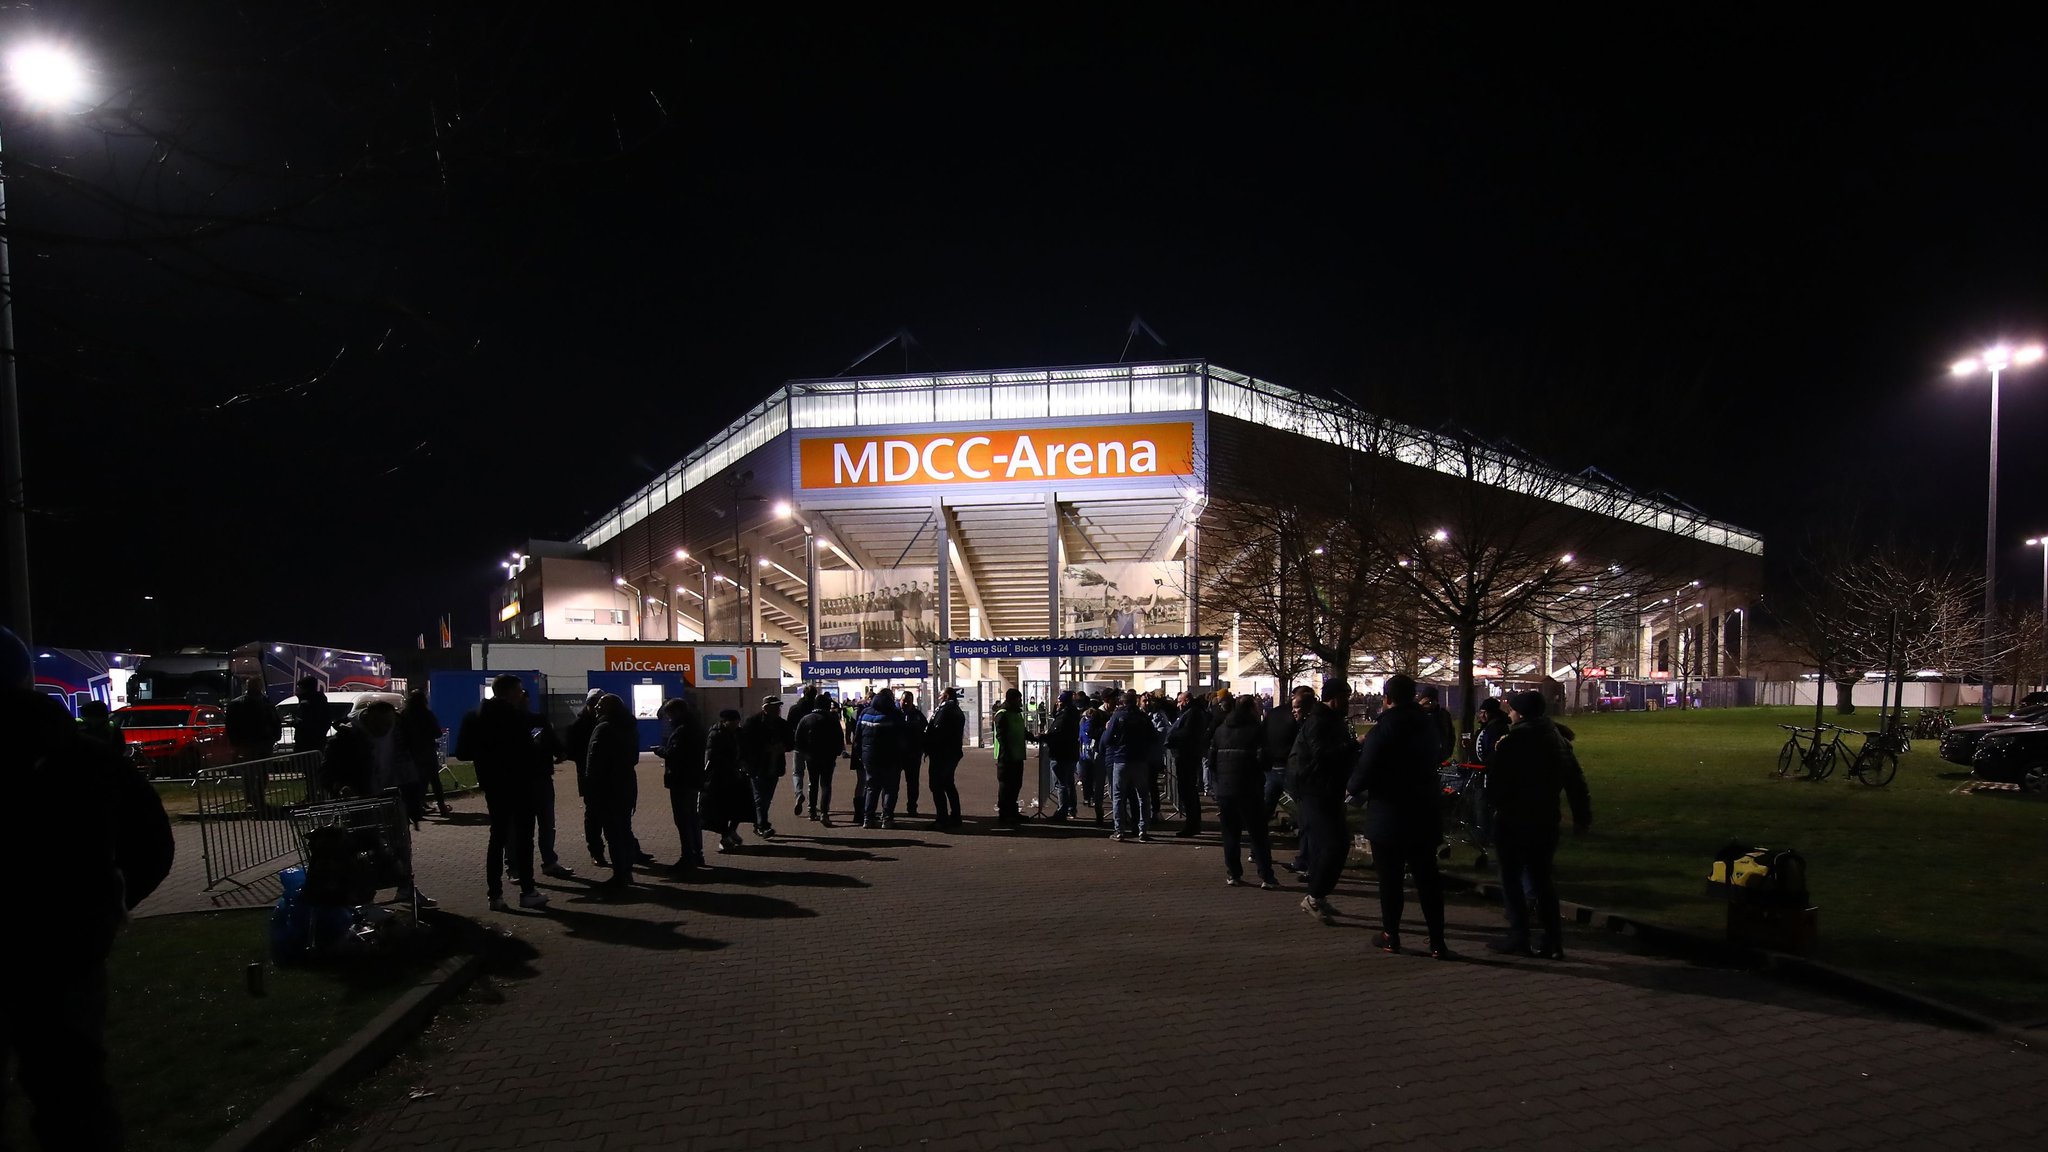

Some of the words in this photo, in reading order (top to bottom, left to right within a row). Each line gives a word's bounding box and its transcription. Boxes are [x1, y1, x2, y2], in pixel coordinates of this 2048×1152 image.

[833, 435, 1157, 484] MDCC-Arena
[824, 634, 853, 648] 1959
[954, 645, 989, 654] Eingang
[990, 643, 1008, 653] Süd
[1014, 644, 1039, 652] Block
[1041, 644, 1052, 652] 19
[1058, 644, 1069, 652] 24
[1078, 643, 1114, 653] Eingang
[1116, 642, 1134, 651] Süd
[1140, 642, 1166, 651] Block
[1168, 642, 1179, 650] 16
[1187, 641, 1197, 650] 18
[611, 661, 691, 672] MDCC-Arena
[808, 666, 842, 676] Zugang
[843, 665, 921, 675] Akkreditierungen
